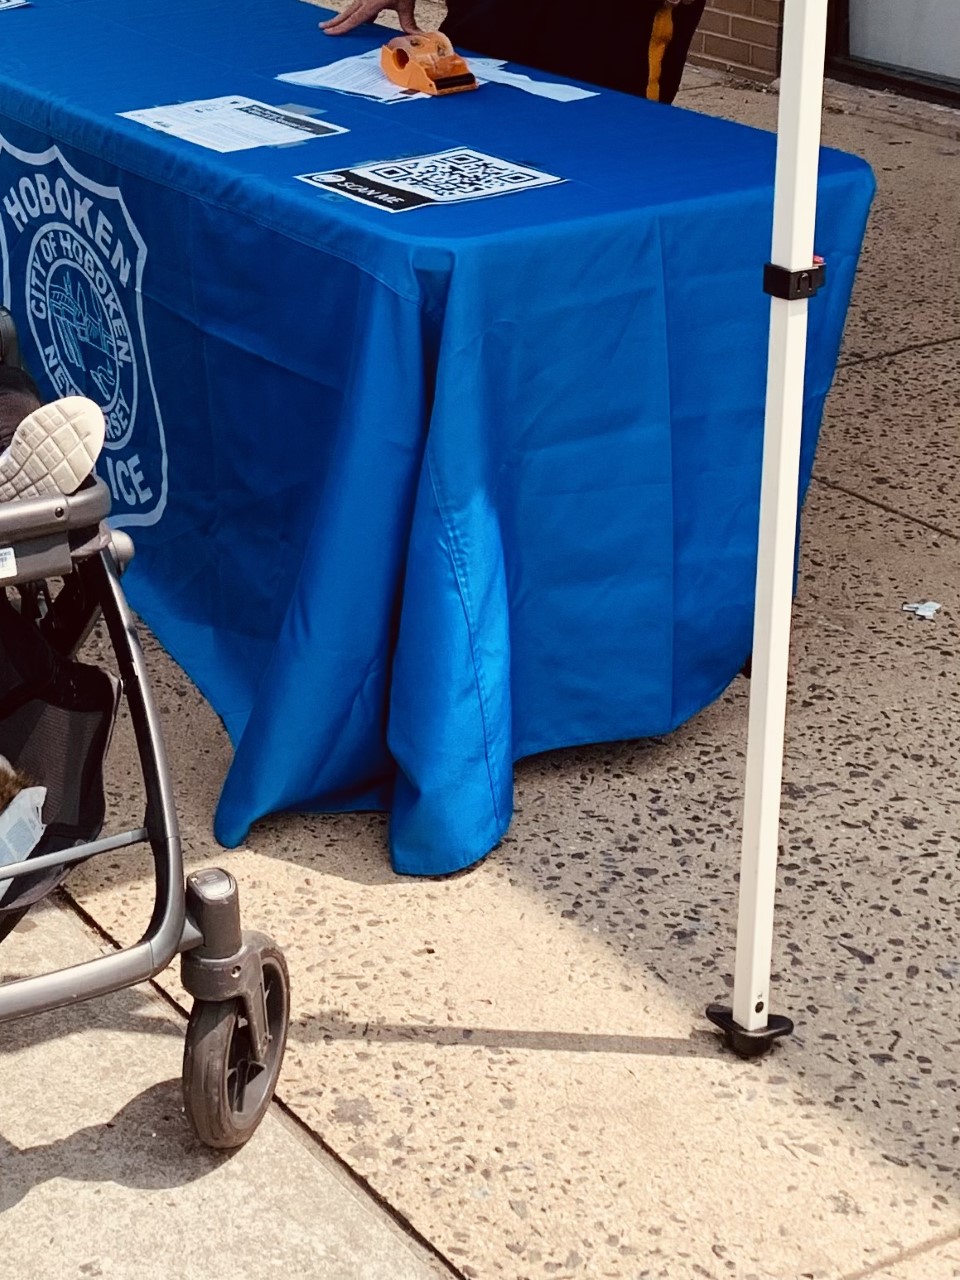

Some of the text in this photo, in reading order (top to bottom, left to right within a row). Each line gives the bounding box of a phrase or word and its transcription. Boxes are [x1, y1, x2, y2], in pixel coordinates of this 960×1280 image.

[337, 182, 405, 204] SCAN ME
[2, 173, 132, 288] HOBOKEN
[30, 252, 47, 320] CITY
[40, 231, 58, 263] OF
[104, 388, 131, 440] RSEY
[105, 454, 154, 506] ICE
